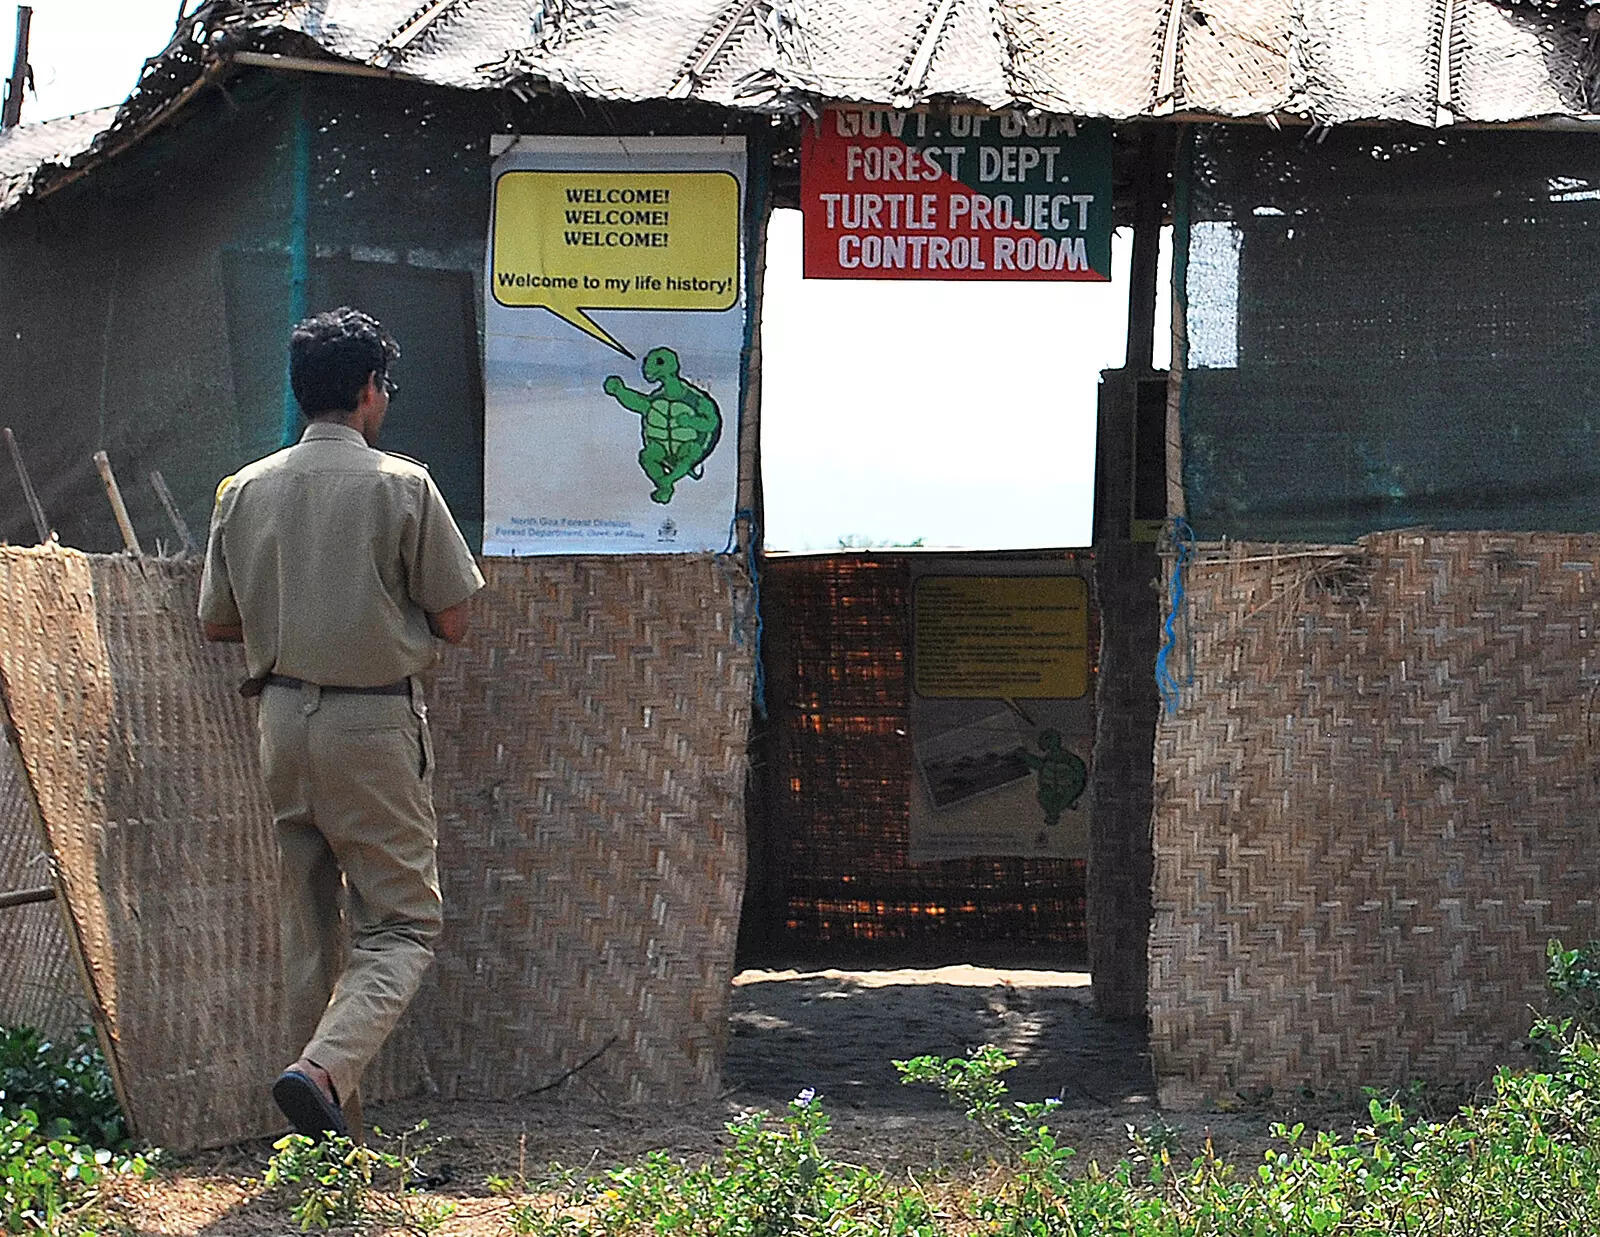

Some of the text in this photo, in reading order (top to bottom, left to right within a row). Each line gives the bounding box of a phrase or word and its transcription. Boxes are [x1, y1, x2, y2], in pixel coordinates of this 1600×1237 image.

[846, 145, 1070, 183] FOREST DEPT.
[565, 188, 670, 204] WELCOME!
[564, 210, 669, 226] WELCOME!
[819, 193, 1094, 231] TURTLE PROJECT
[563, 231, 669, 248] WELCOME!
[838, 234, 1089, 272] CONTROL ROOM
[498, 272, 733, 295] Welcome to my life history!
[511, 516, 631, 528] North Goa Forest Division
[495, 527, 526, 536] Forest
